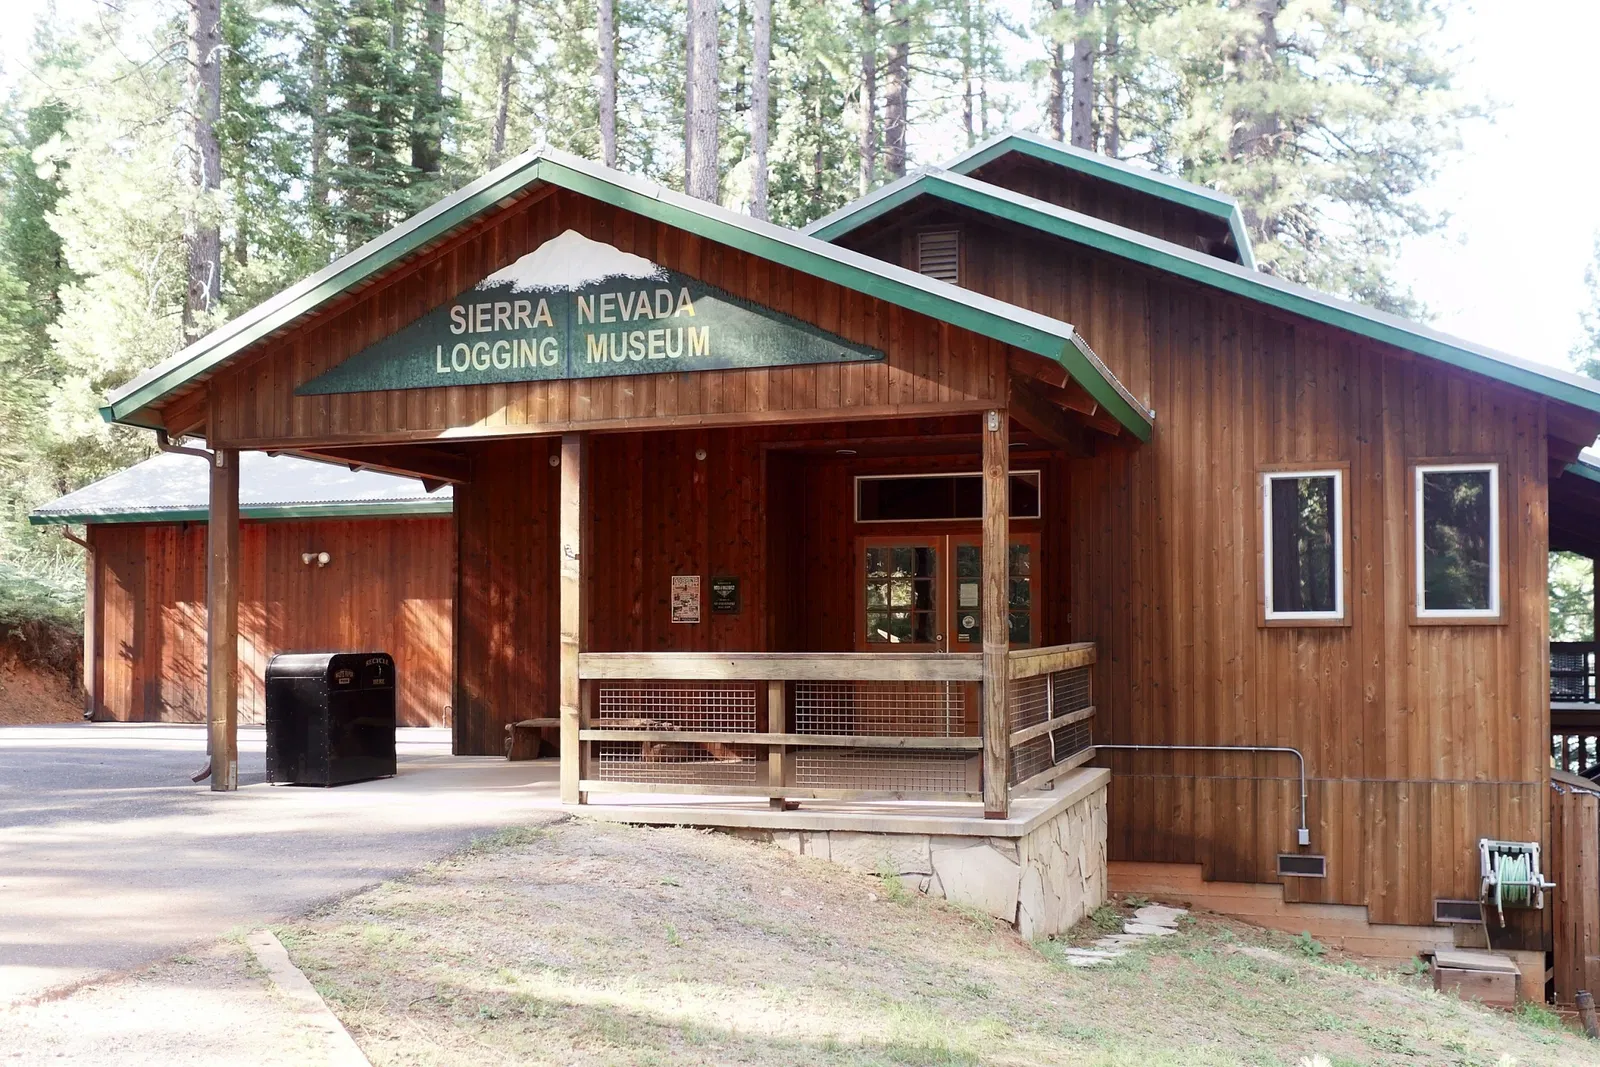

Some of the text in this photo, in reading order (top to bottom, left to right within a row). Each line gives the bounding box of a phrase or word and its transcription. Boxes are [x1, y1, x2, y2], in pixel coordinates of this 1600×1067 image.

[449, 287, 696, 335] SIERRA NEVADA
[436, 325, 710, 374] LOGGING MUSEUM
[365, 657, 389, 666] RECYCLE
